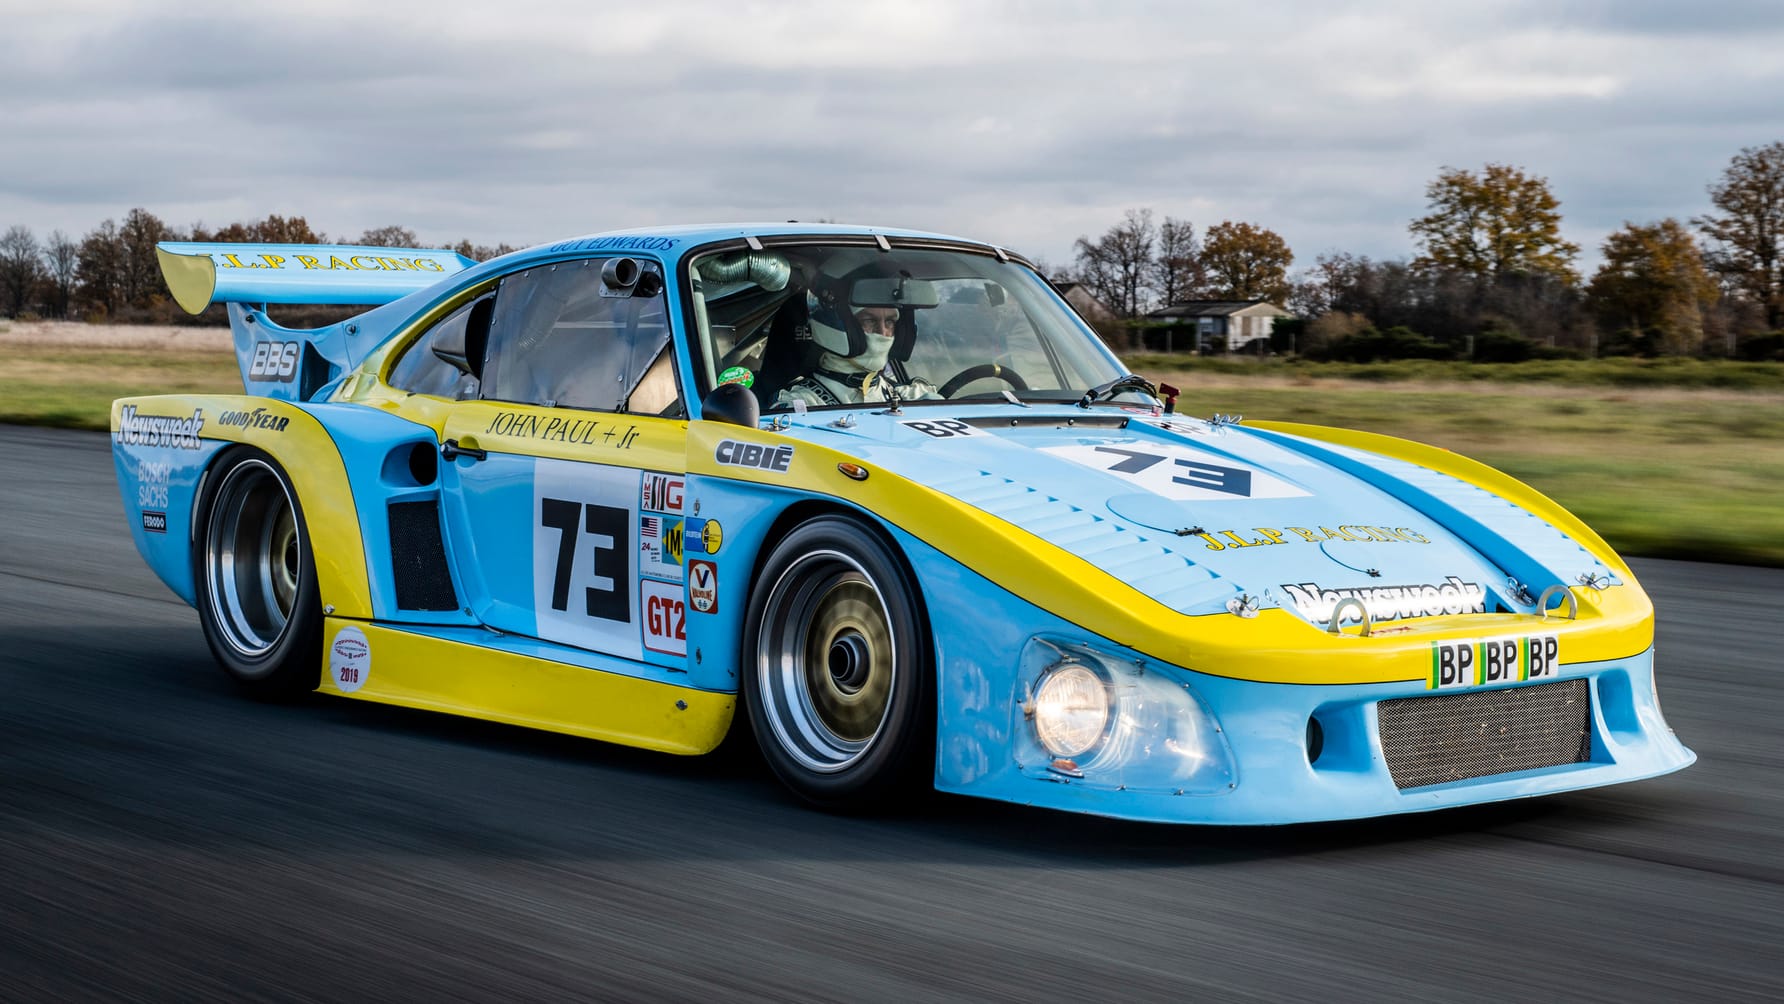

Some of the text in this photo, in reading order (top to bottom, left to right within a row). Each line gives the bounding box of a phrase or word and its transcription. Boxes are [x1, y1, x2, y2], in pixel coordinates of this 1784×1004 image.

[292, 254, 446, 273] RACING
[250, 341, 298, 381] BBS
[117, 404, 205, 450] Newsweek
[218, 408, 290, 432] GOODYEAR
[485, 412, 546, 439] JOHN
[541, 417, 600, 446] PAUL
[616, 425, 640, 449] Jr
[902, 417, 972, 438] BP
[138, 462, 170, 484] BOSCH
[1094, 446, 1252, 498] 73
[138, 485, 169, 509] SACHS
[143, 514, 165, 529] FERODO
[641, 542, 651, 551] 24
[665, 526, 684, 557] IM
[1197, 525, 1431, 551] J.L.P RACING
[542, 497, 631, 624] 73
[647, 594, 687, 641] GT2
[1439, 636, 1558, 686] BP BP BP
[340, 666, 359, 684] 2019
